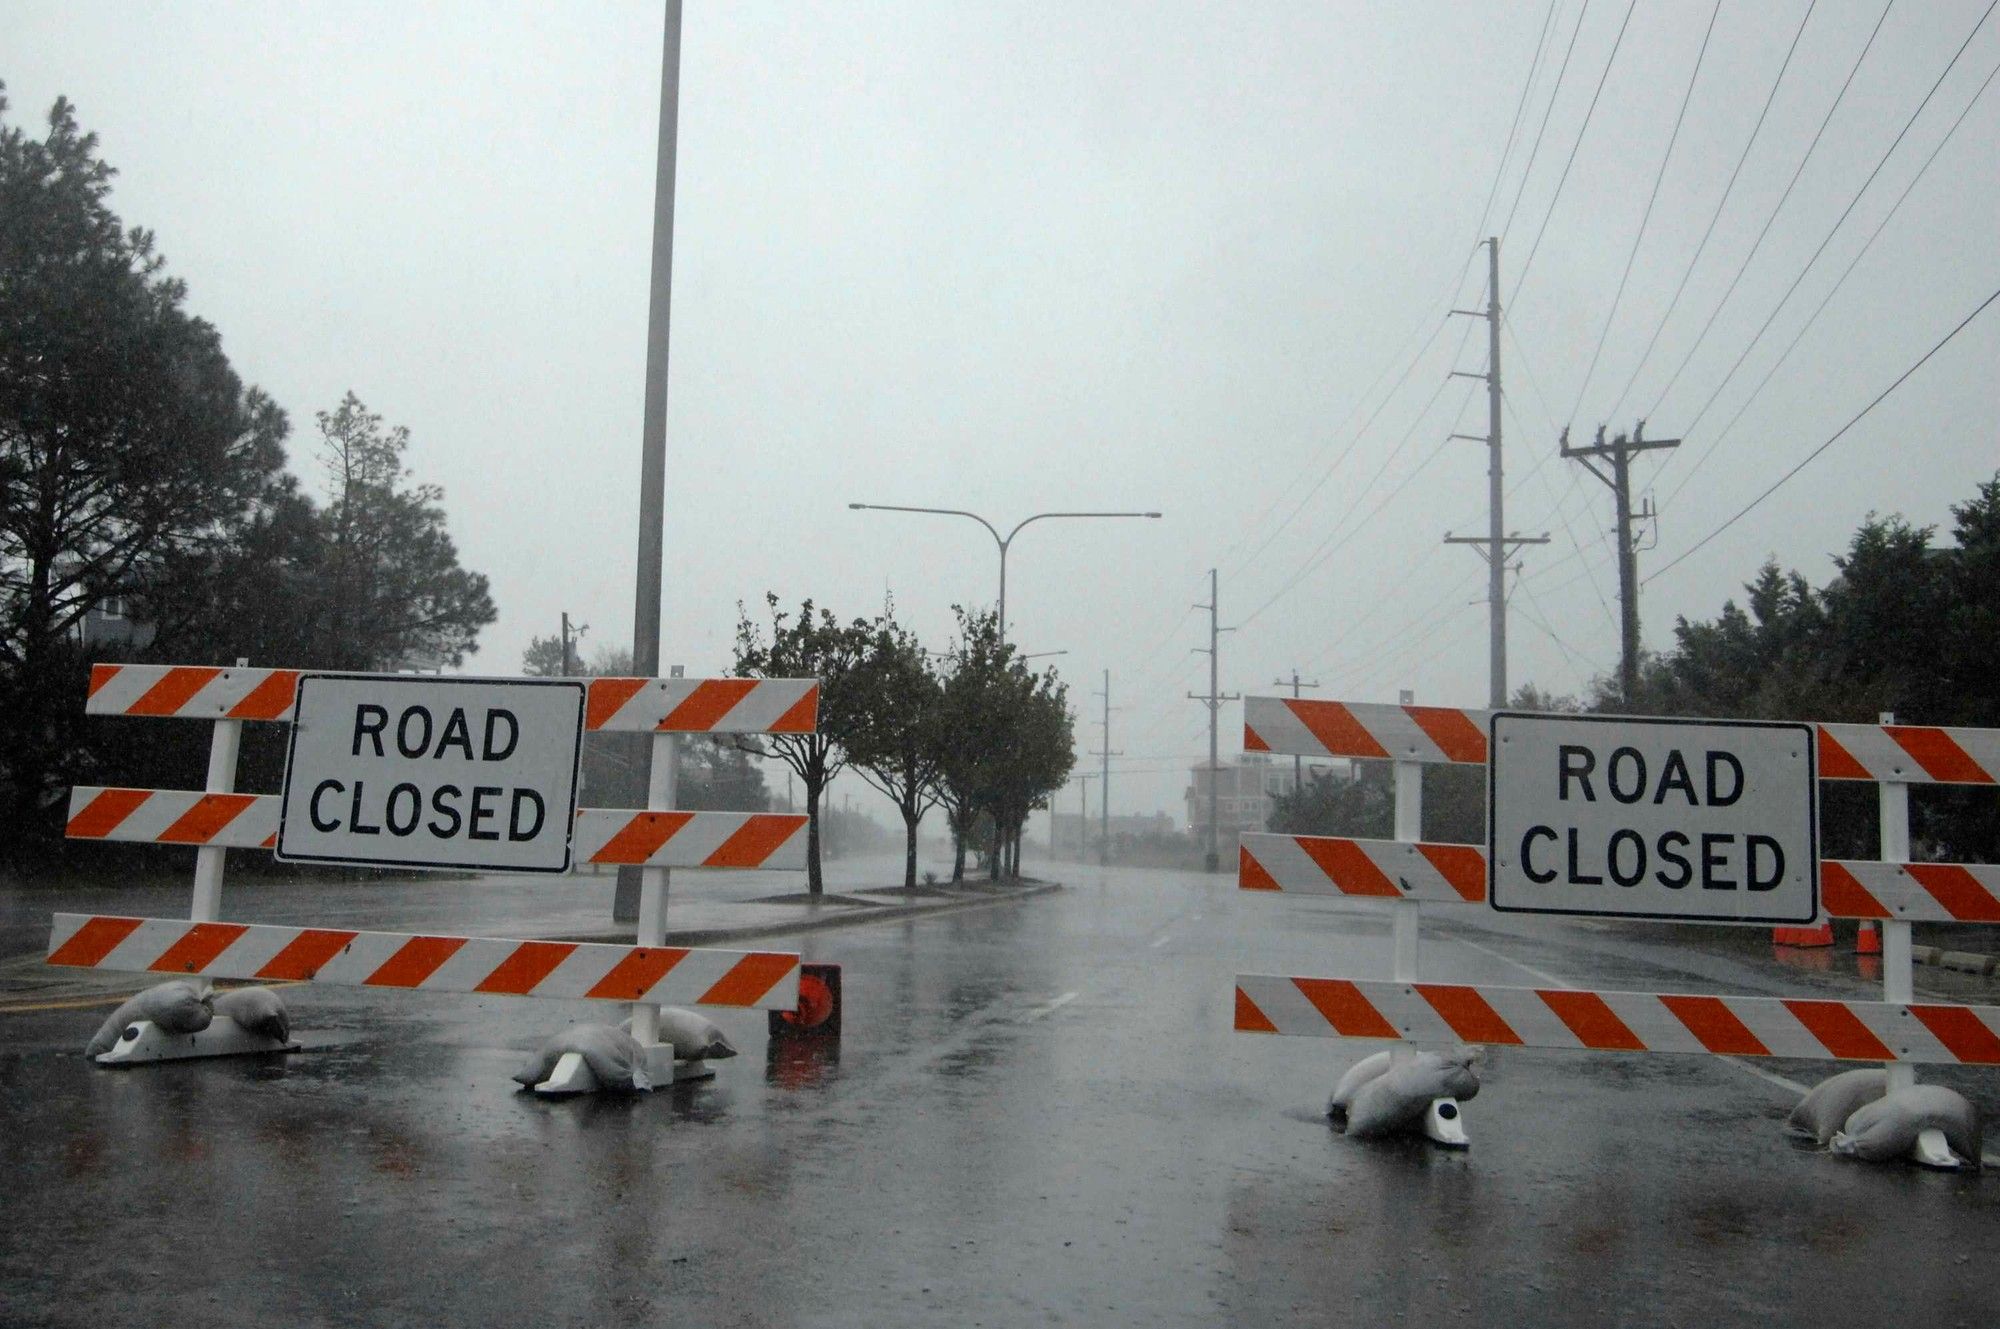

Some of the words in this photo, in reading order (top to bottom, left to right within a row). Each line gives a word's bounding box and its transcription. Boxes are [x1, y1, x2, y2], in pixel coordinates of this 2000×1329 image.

[351, 703, 520, 763] ROAD
[1558, 744, 1745, 807] ROAD
[309, 778, 546, 843] CLOSED
[1519, 824, 1786, 893] CLOSED
